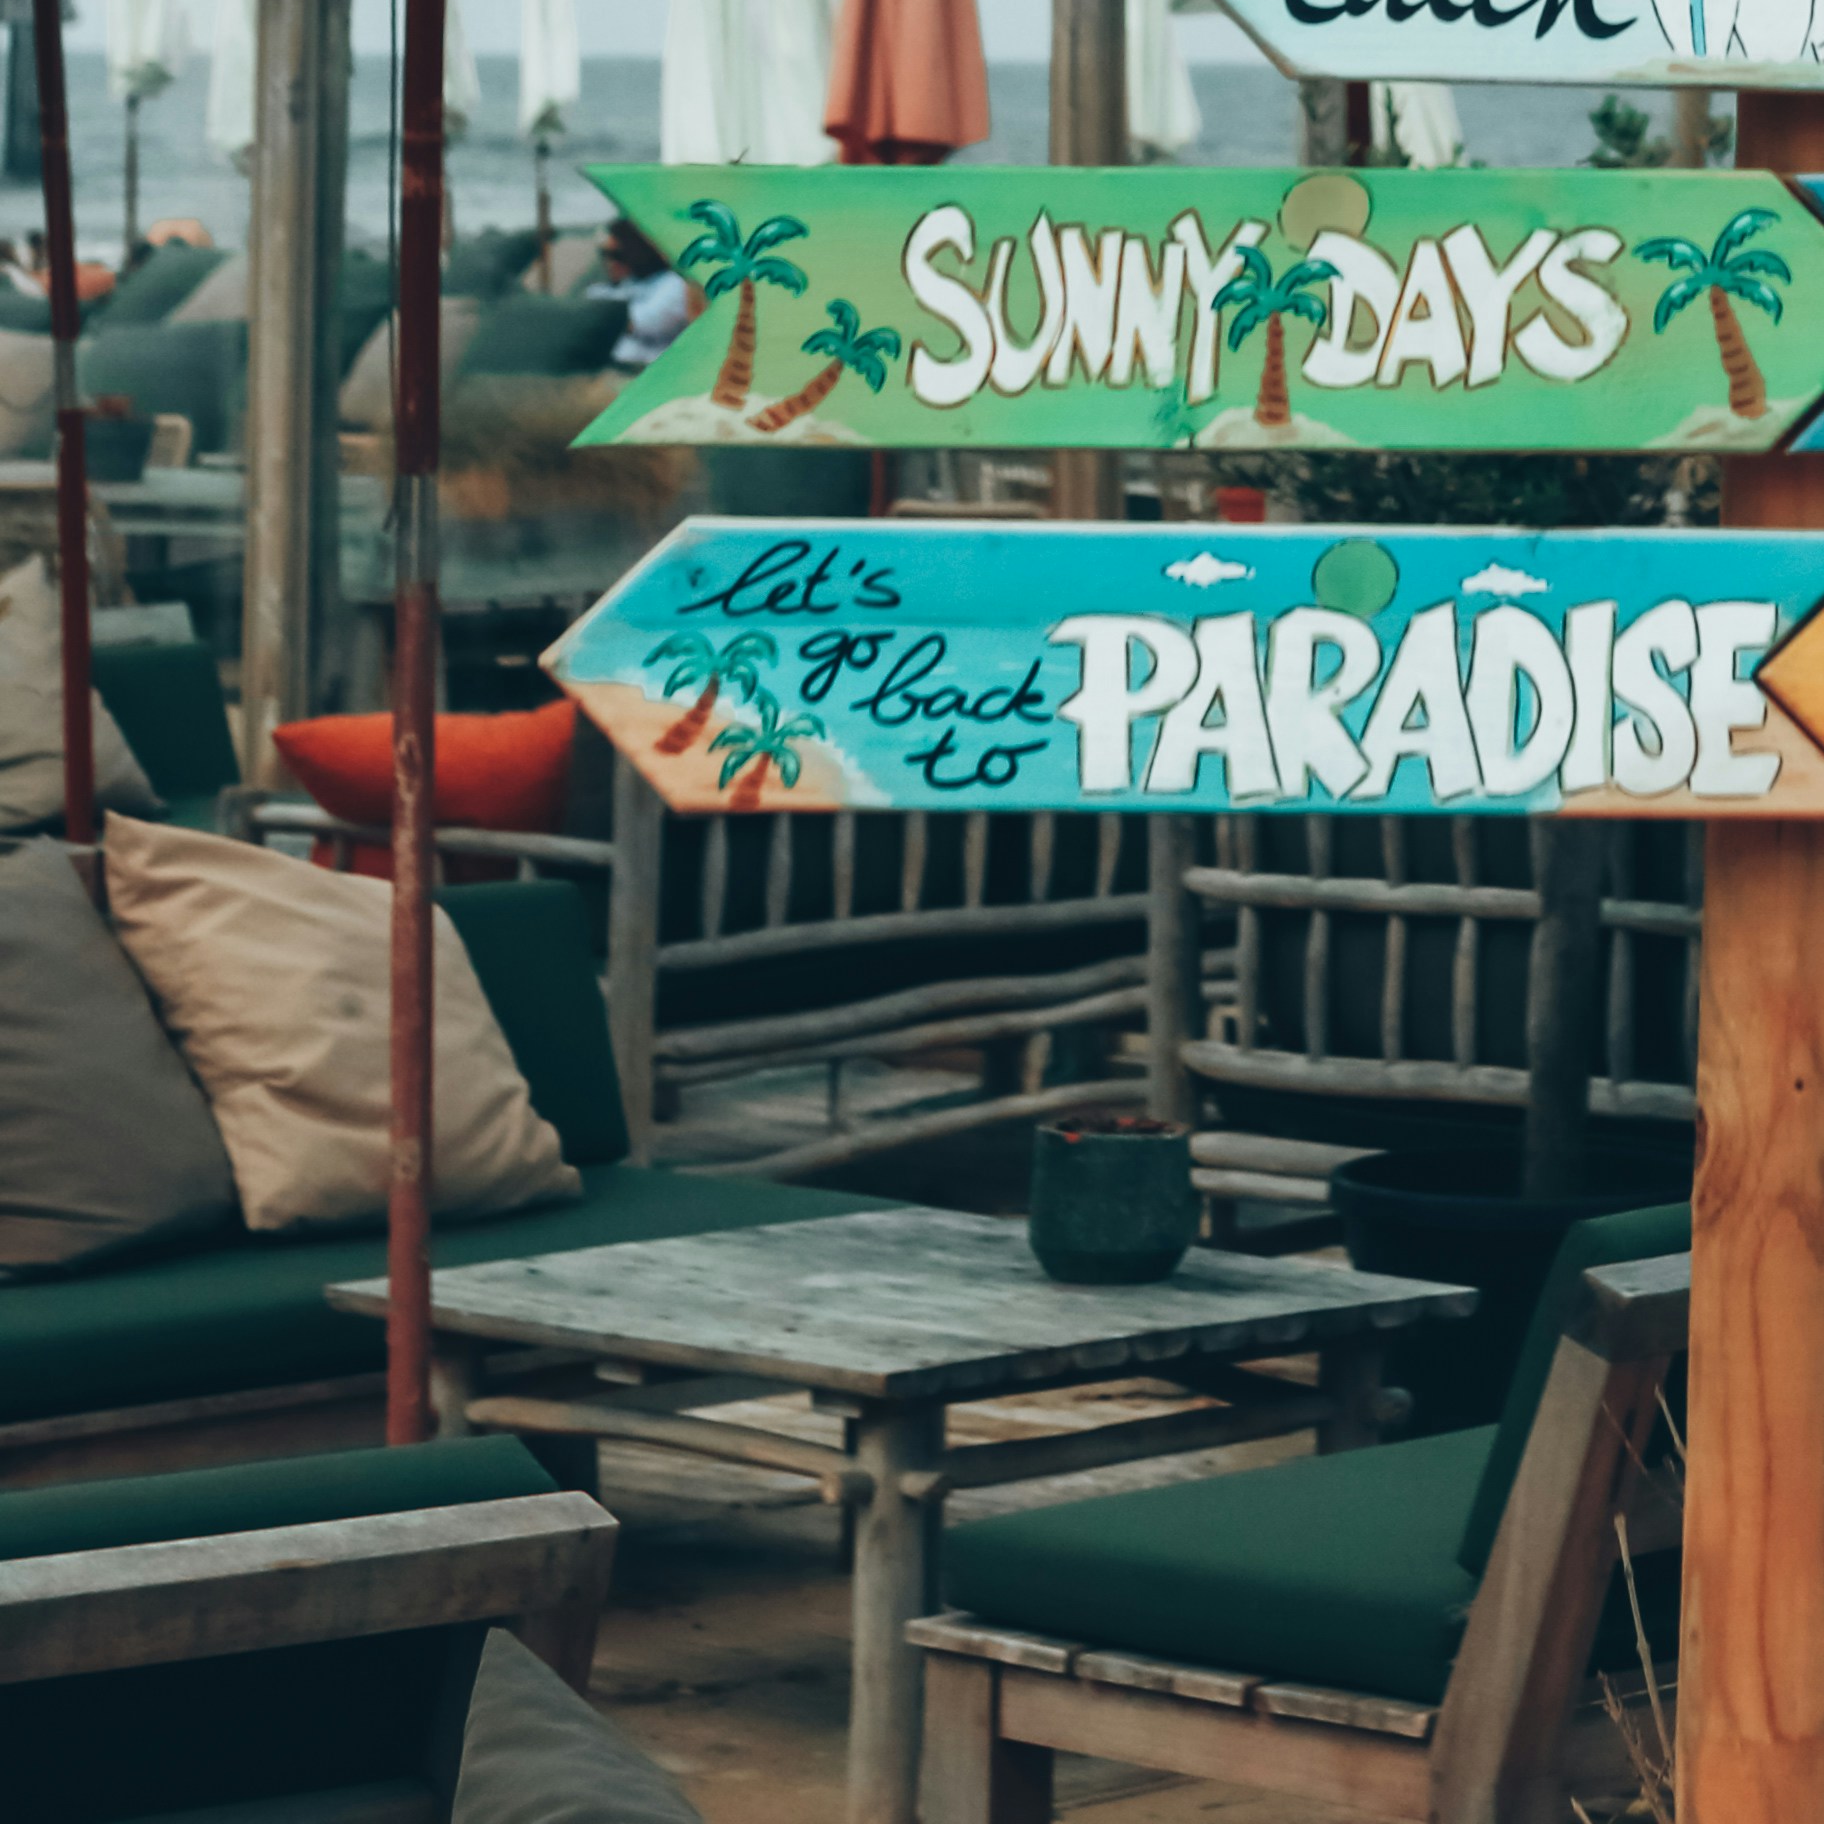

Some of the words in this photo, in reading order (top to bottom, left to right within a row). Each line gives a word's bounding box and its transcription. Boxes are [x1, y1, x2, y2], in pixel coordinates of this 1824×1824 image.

[900, 201, 1270, 409] SUNNY
[1298, 221, 1628, 392] DAYS
[682, 540, 904, 620] let's
[800, 625, 889, 701] go
[851, 638, 1055, 729] back
[1045, 598, 1784, 805] PARADISE
[904, 736, 1048, 792] to
